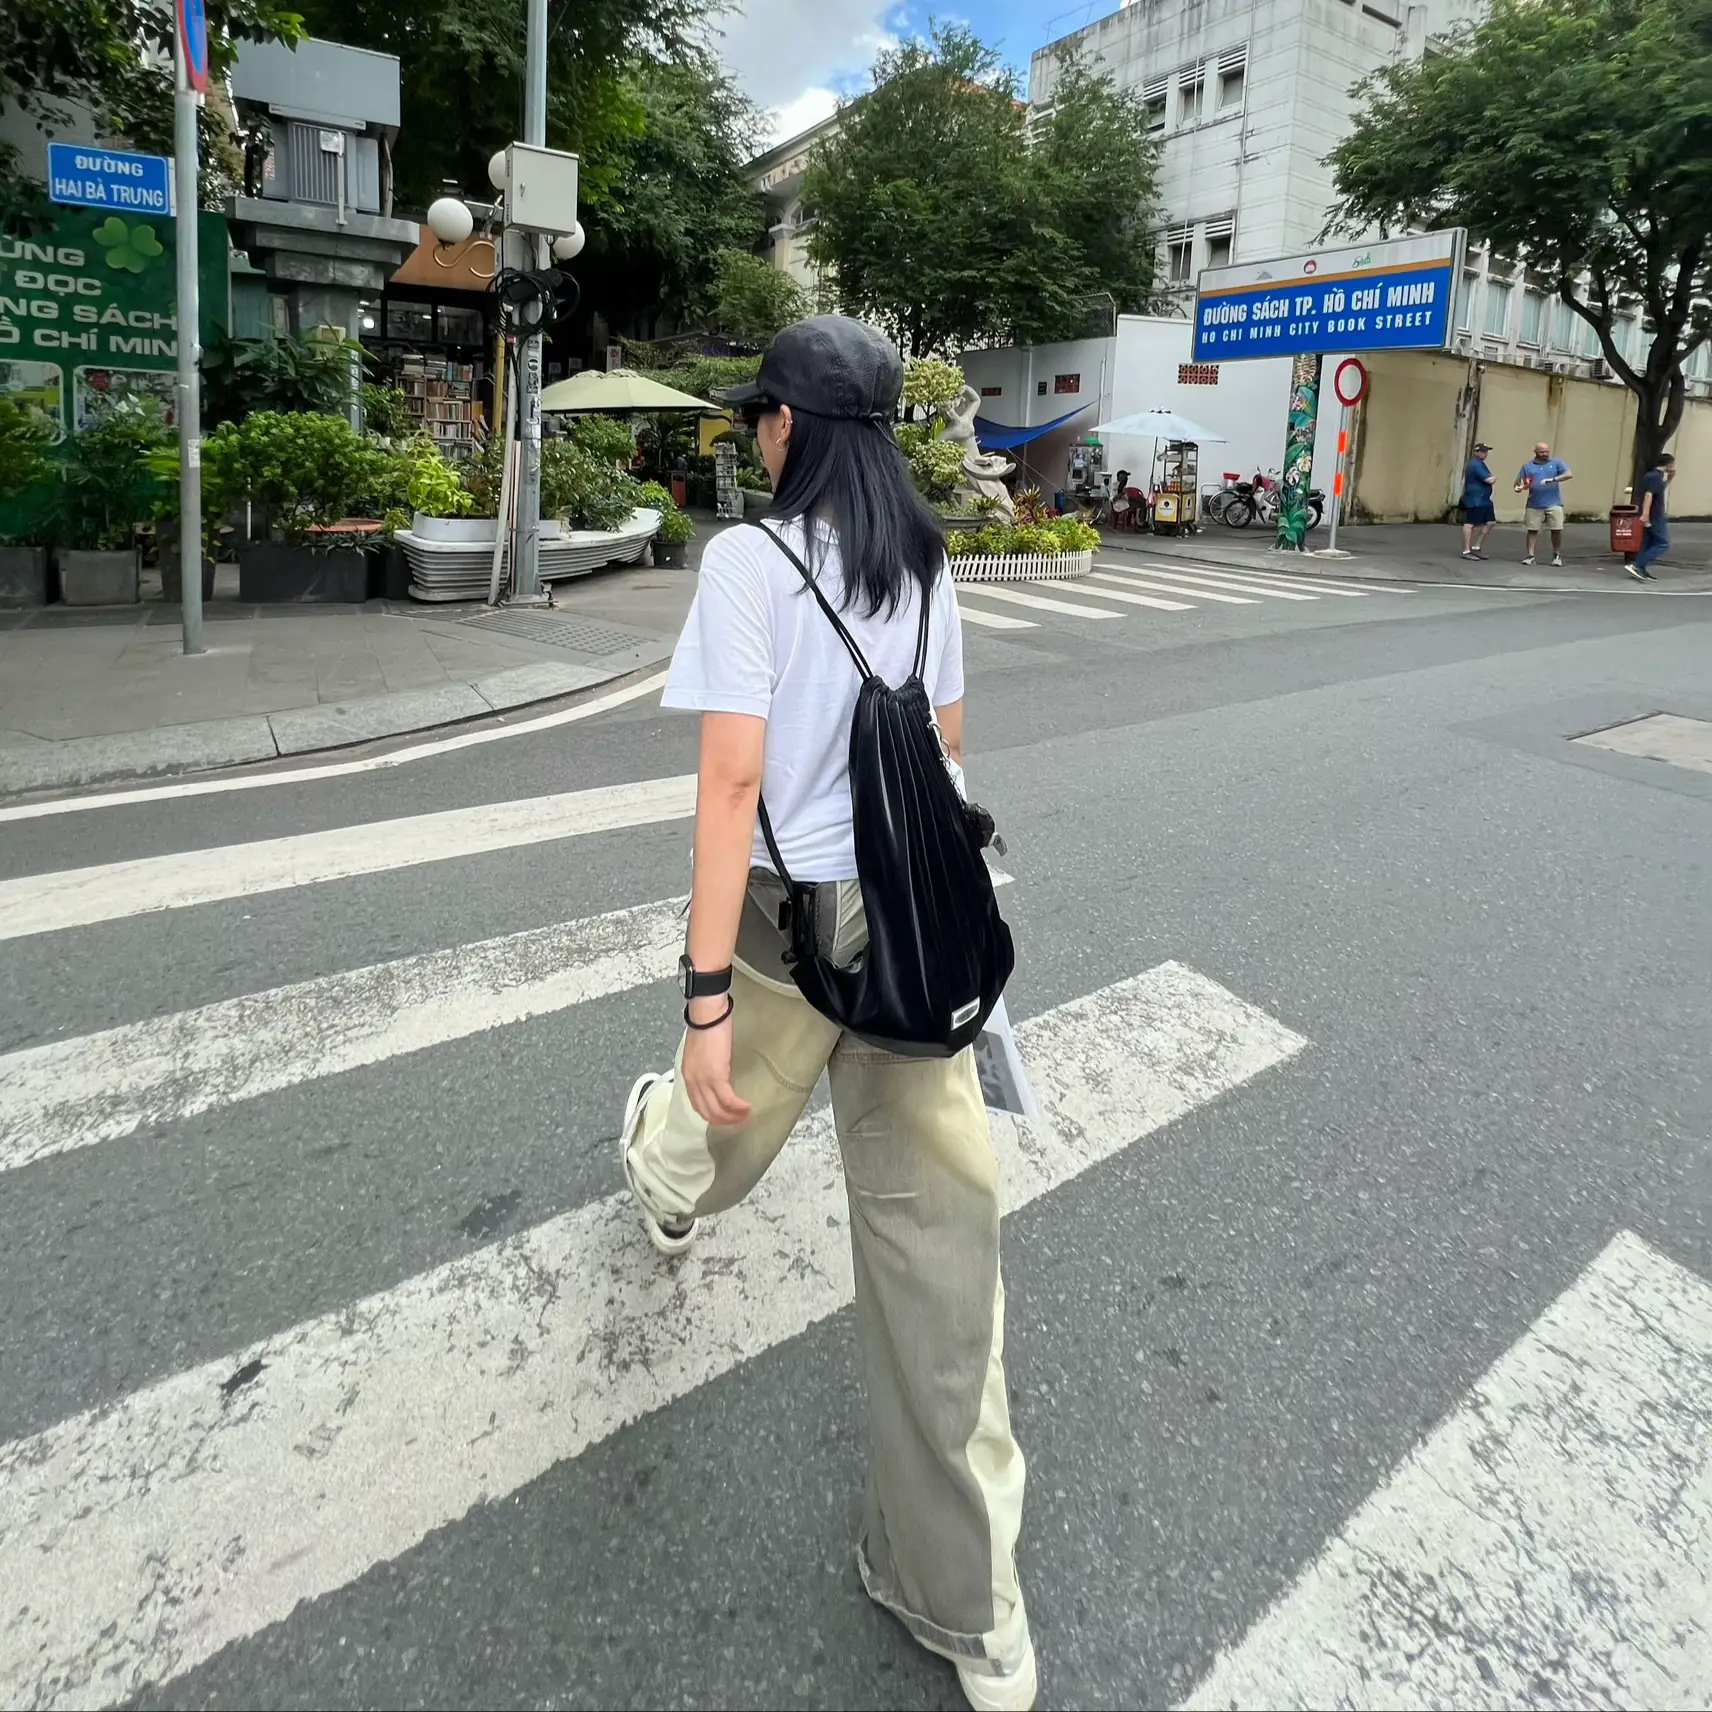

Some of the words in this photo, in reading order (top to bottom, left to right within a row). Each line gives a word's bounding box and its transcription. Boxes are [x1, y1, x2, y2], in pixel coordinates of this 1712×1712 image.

[75, 155, 143, 177] ĐƯỜNG
[55, 178, 82, 198] HAI
[86, 178, 107, 201] BÀ
[110, 184, 164, 207] TRƯNG
[14, 270, 102, 296] ĐỌC
[73, 302, 178, 331] SÁCH
[1203, 301, 1248, 326] ĐƯỜNG
[1252, 295, 1289, 321] SÁCH
[1295, 296, 1317, 316] TP.
[1323, 287, 1345, 313] HỒ
[1351, 282, 1383, 311] CHÍ
[1387, 281, 1435, 308] MINH
[1202, 331, 1216, 344] HO
[1222, 328, 1243, 342] CHI
[1249, 324, 1281, 340] MINH
[1289, 320, 1320, 336] CITY
[1327, 316, 1366, 333] BOOK
[1375, 311, 1432, 330] STREET
[33, 328, 98, 351] CHÍ
[109, 335, 178, 358] MIN
